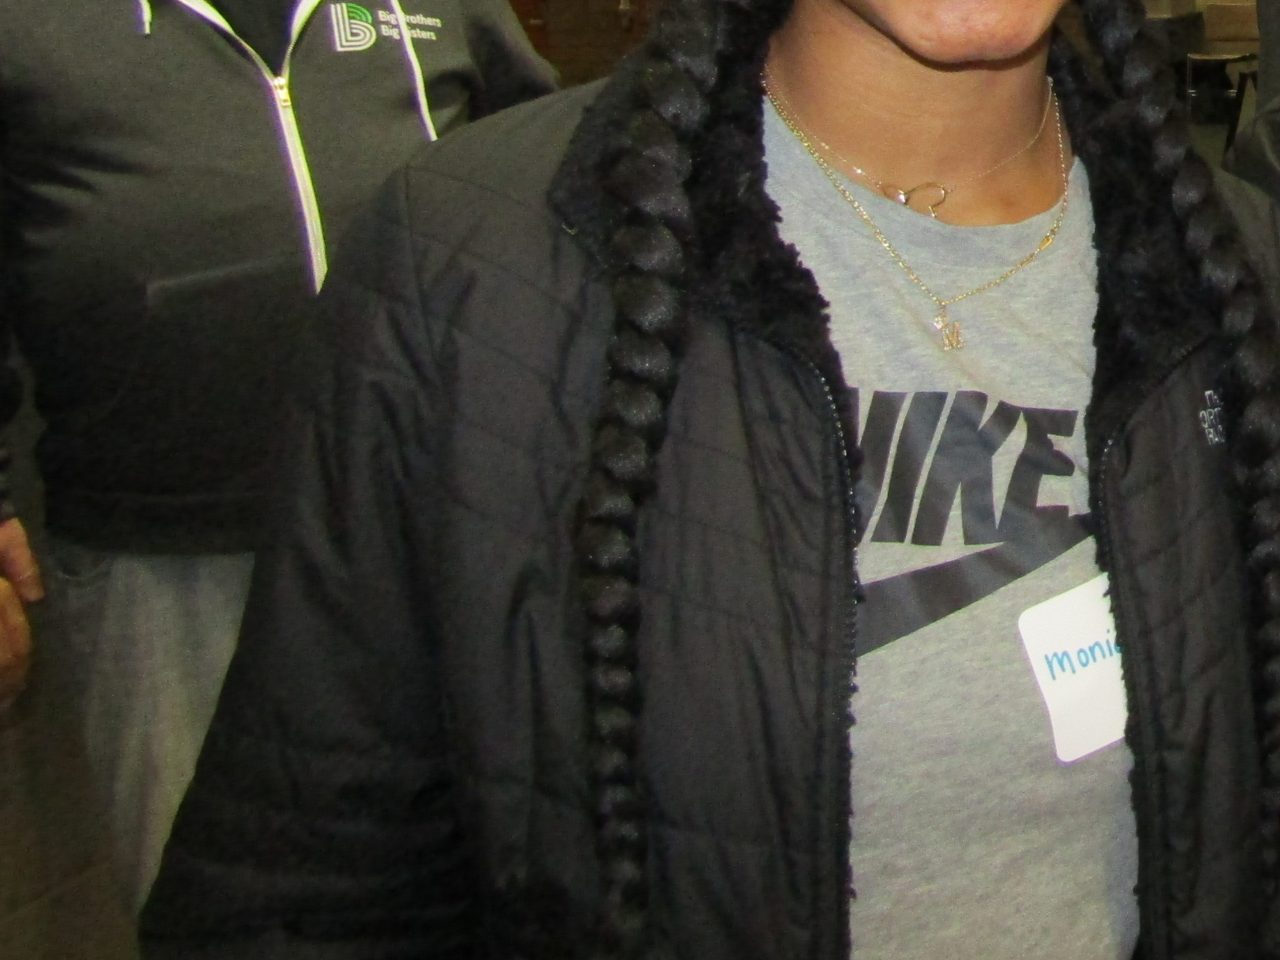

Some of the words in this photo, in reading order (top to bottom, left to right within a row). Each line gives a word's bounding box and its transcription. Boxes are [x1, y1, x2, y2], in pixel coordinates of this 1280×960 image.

[377, 9, 399, 25] Big
[406, 13, 442, 28] rothers
[380, 24, 401, 40] Big
[408, 26, 437, 41] isters
